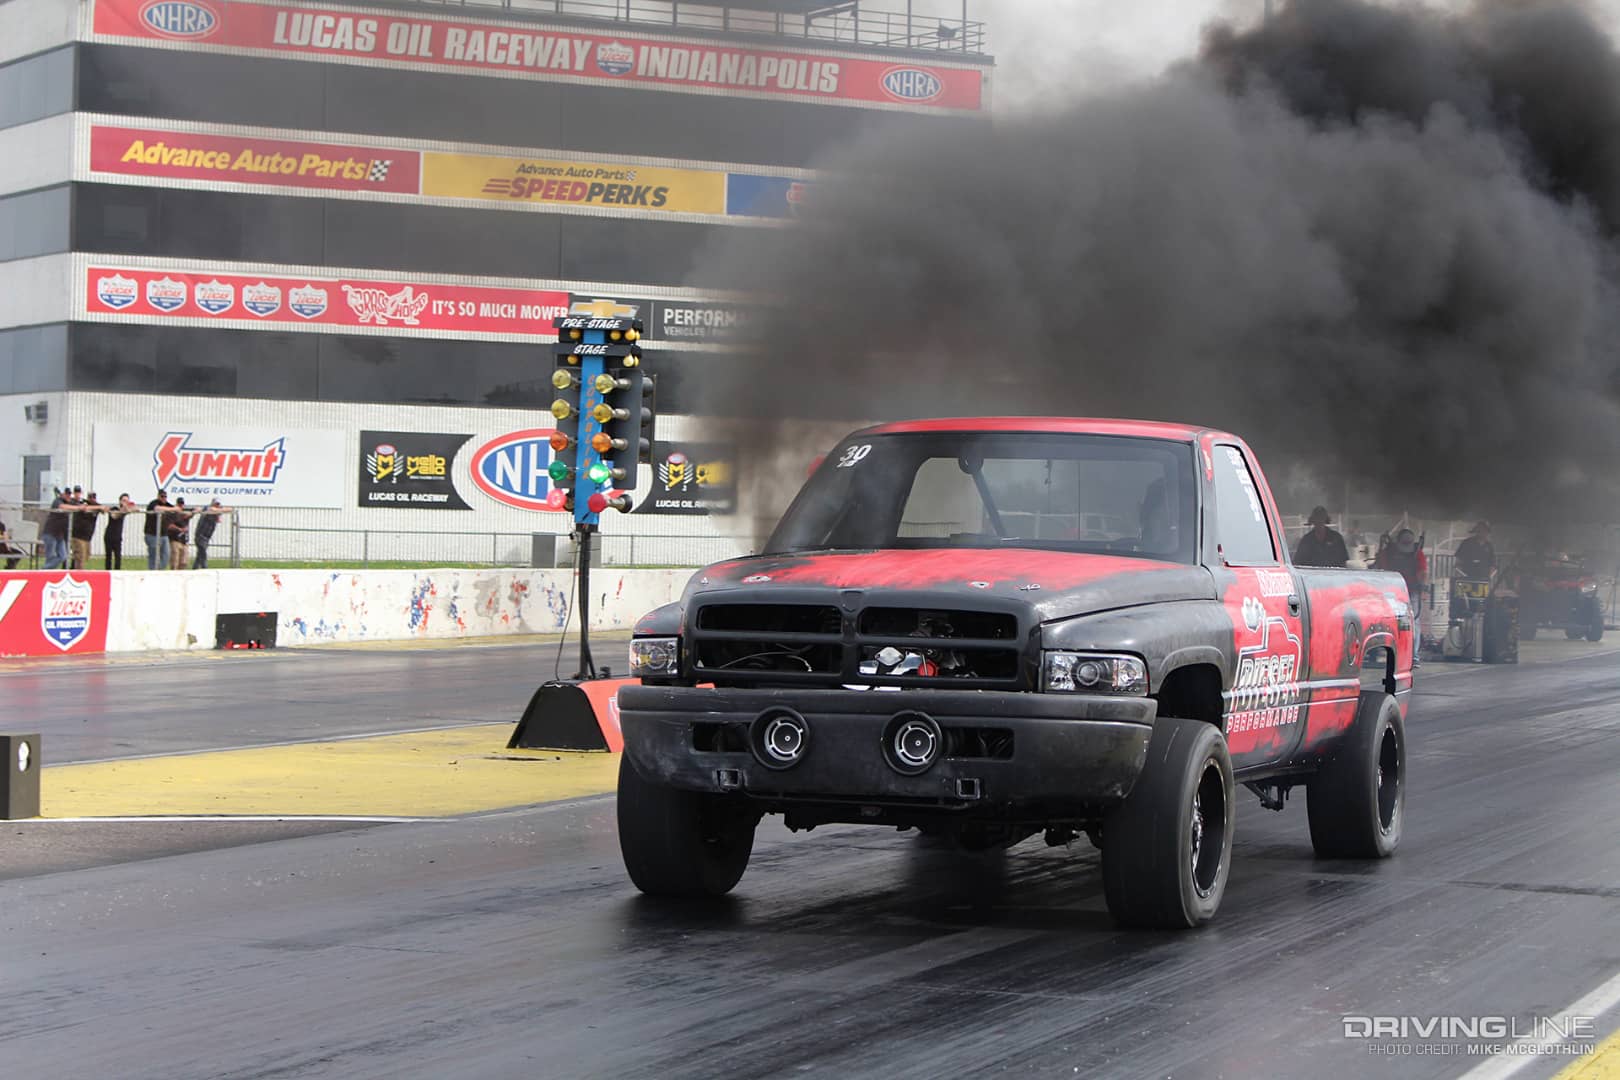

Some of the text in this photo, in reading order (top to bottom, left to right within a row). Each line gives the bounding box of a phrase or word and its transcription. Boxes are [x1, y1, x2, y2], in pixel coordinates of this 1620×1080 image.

[151, 2, 209, 33] NHRA
[273, 11, 593, 72] LUCAS OIL RACEWAY
[637, 45, 840, 94] INDIANAPOLIS
[885, 70, 941, 99] NHRA
[121, 140, 368, 180] Advance Auto Parts
[516, 163, 625, 180] Advance Auto Parts
[508, 177, 669, 207] SPEEDPERKS
[432, 300, 569, 321] IT'S SO MUCH MOWER
[664, 308, 738, 327] PERFORM
[561, 318, 622, 329] PRE-STAGE
[573, 344, 608, 355] STAGE
[170, 486, 273, 495] RACING EQUIPMENT
[368, 492, 449, 502] LUCAS OIL RACEWAY
[655, 500, 680, 508] LUCAS
[49, 600, 86, 616] LUCAS
[1226, 706, 1299, 733] PERFORMANCE
